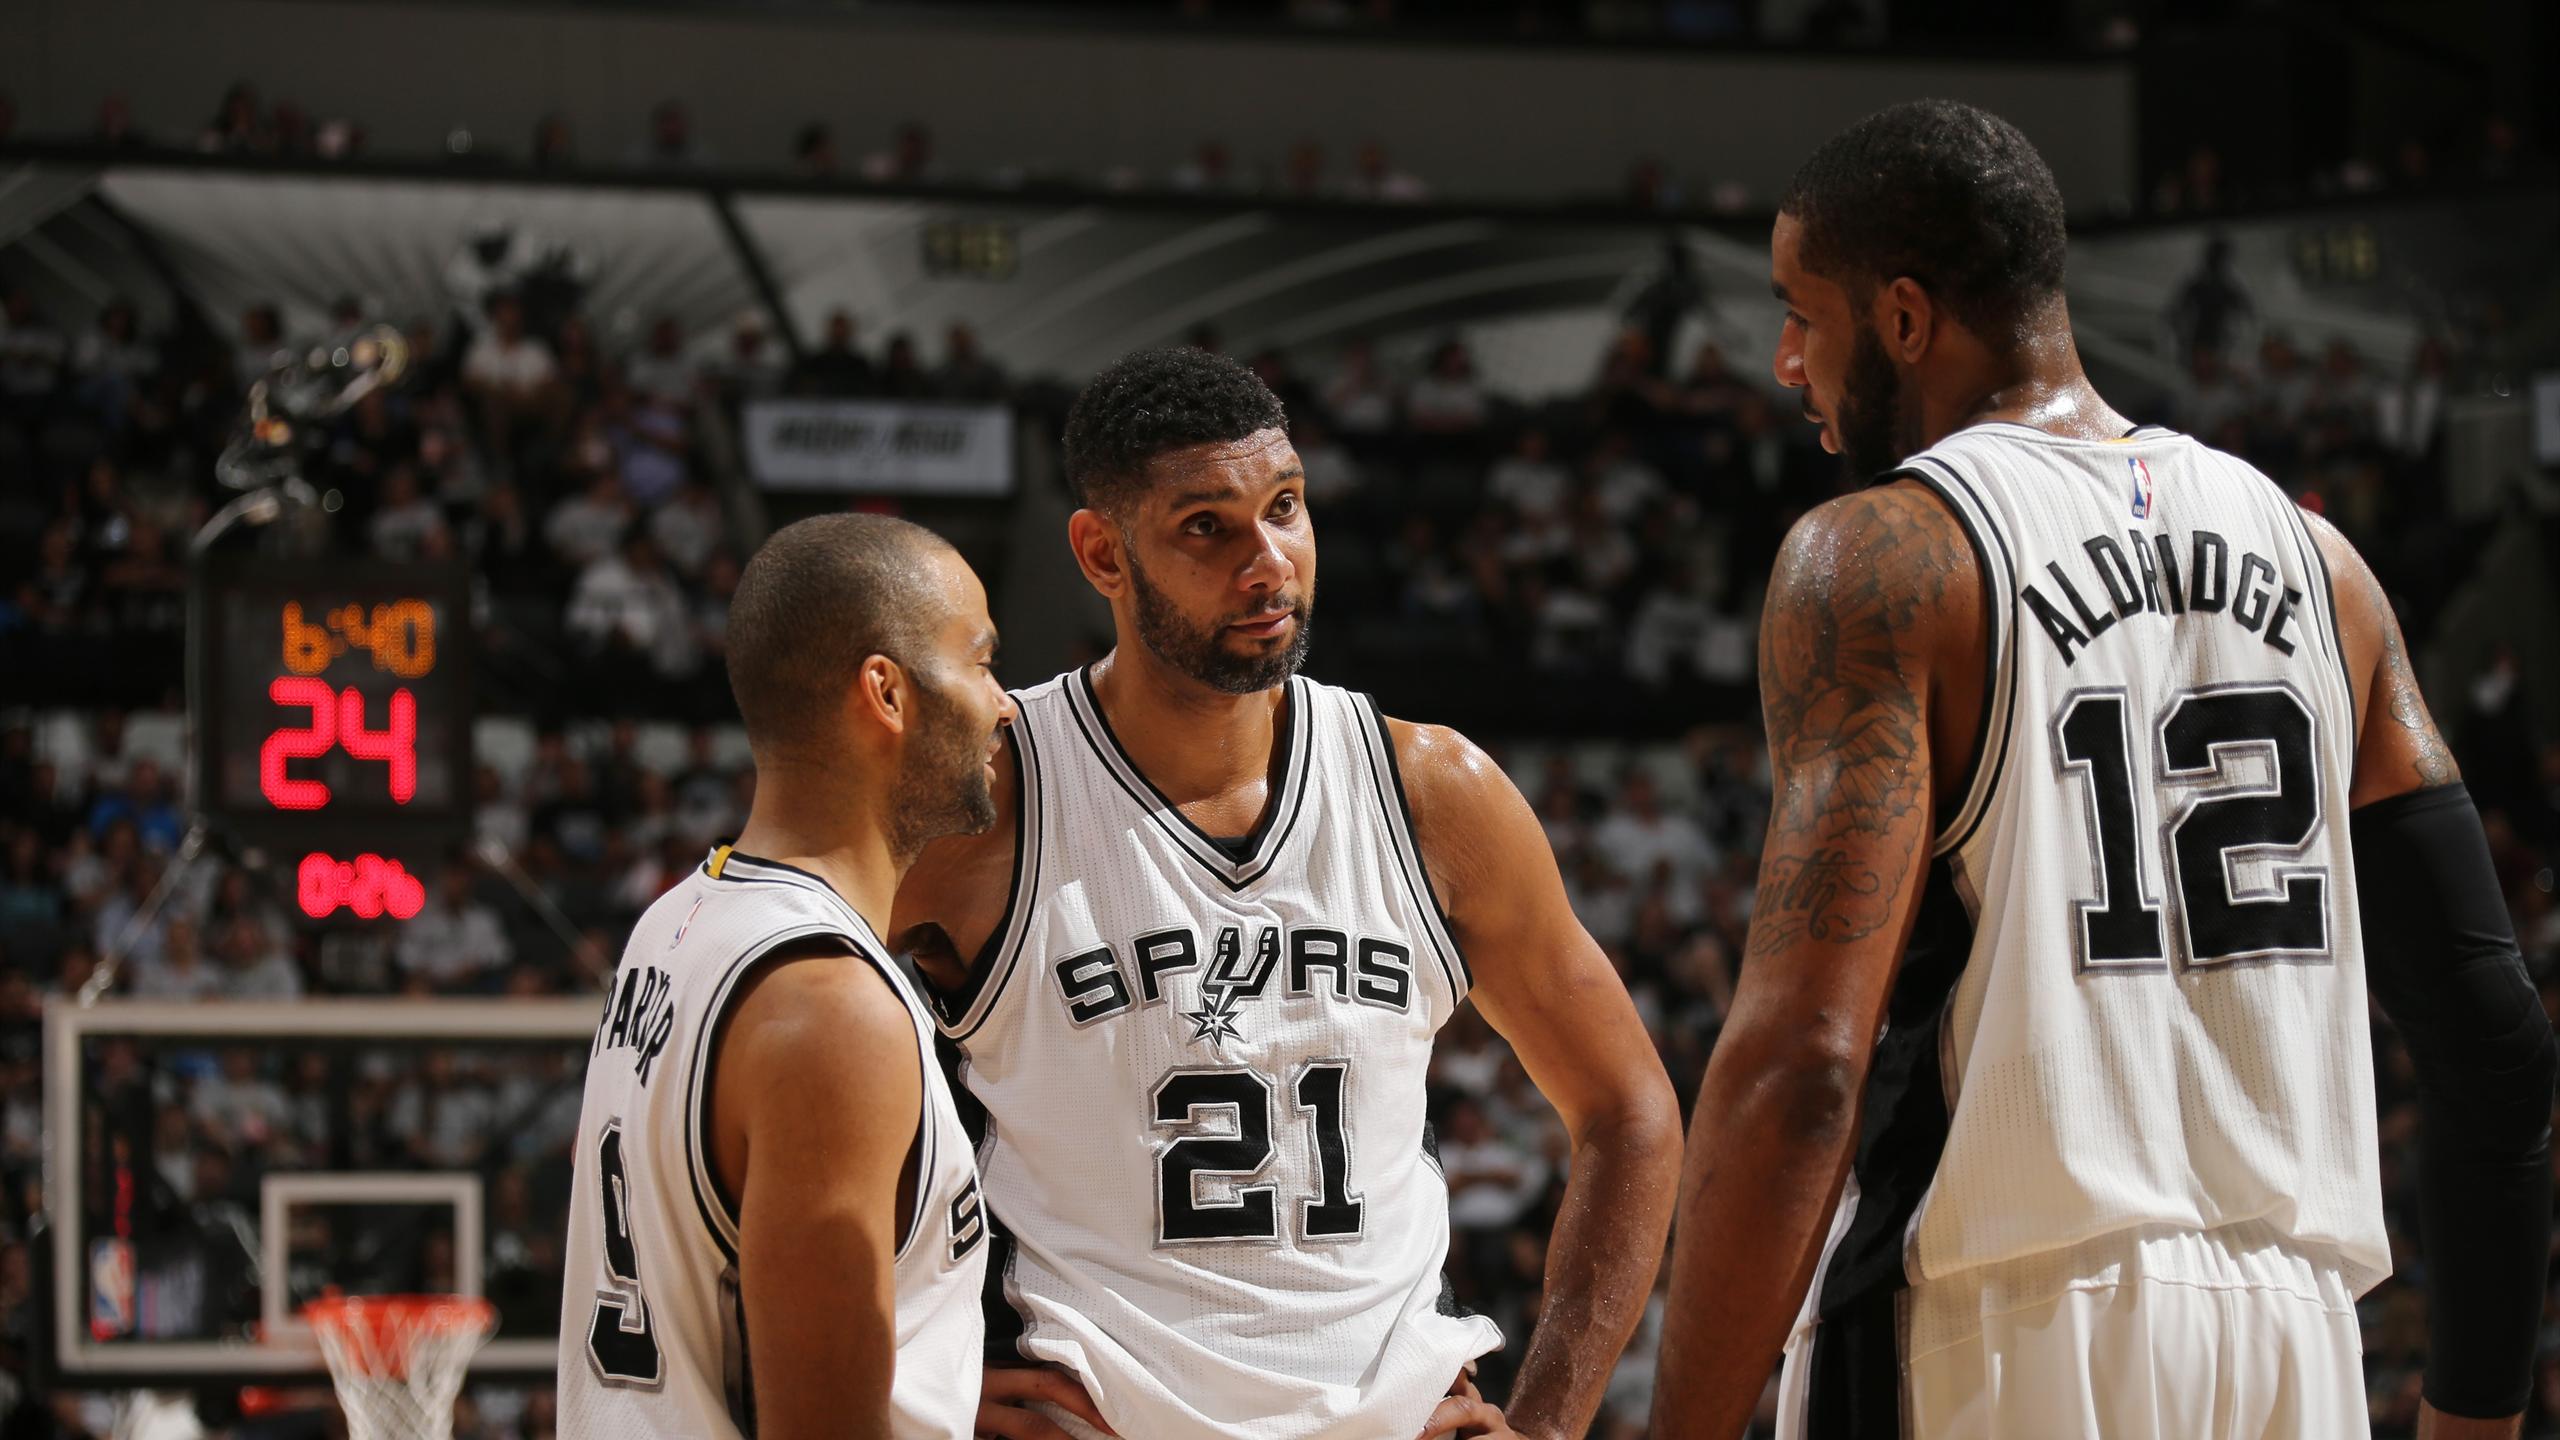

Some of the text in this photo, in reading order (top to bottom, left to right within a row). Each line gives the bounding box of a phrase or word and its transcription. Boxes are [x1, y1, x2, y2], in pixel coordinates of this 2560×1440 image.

[282, 600, 437, 678] 6:40
[2020, 529, 2303, 668] ALDRIDGE
[260, 676, 416, 810] 24
[2048, 679, 2334, 982] 12
[594, 965, 674, 1089] PARKR
[1051, 925, 1412, 1046] SPURS
[1148, 1058, 1366, 1250] 21
[585, 1115, 667, 1393] 9
